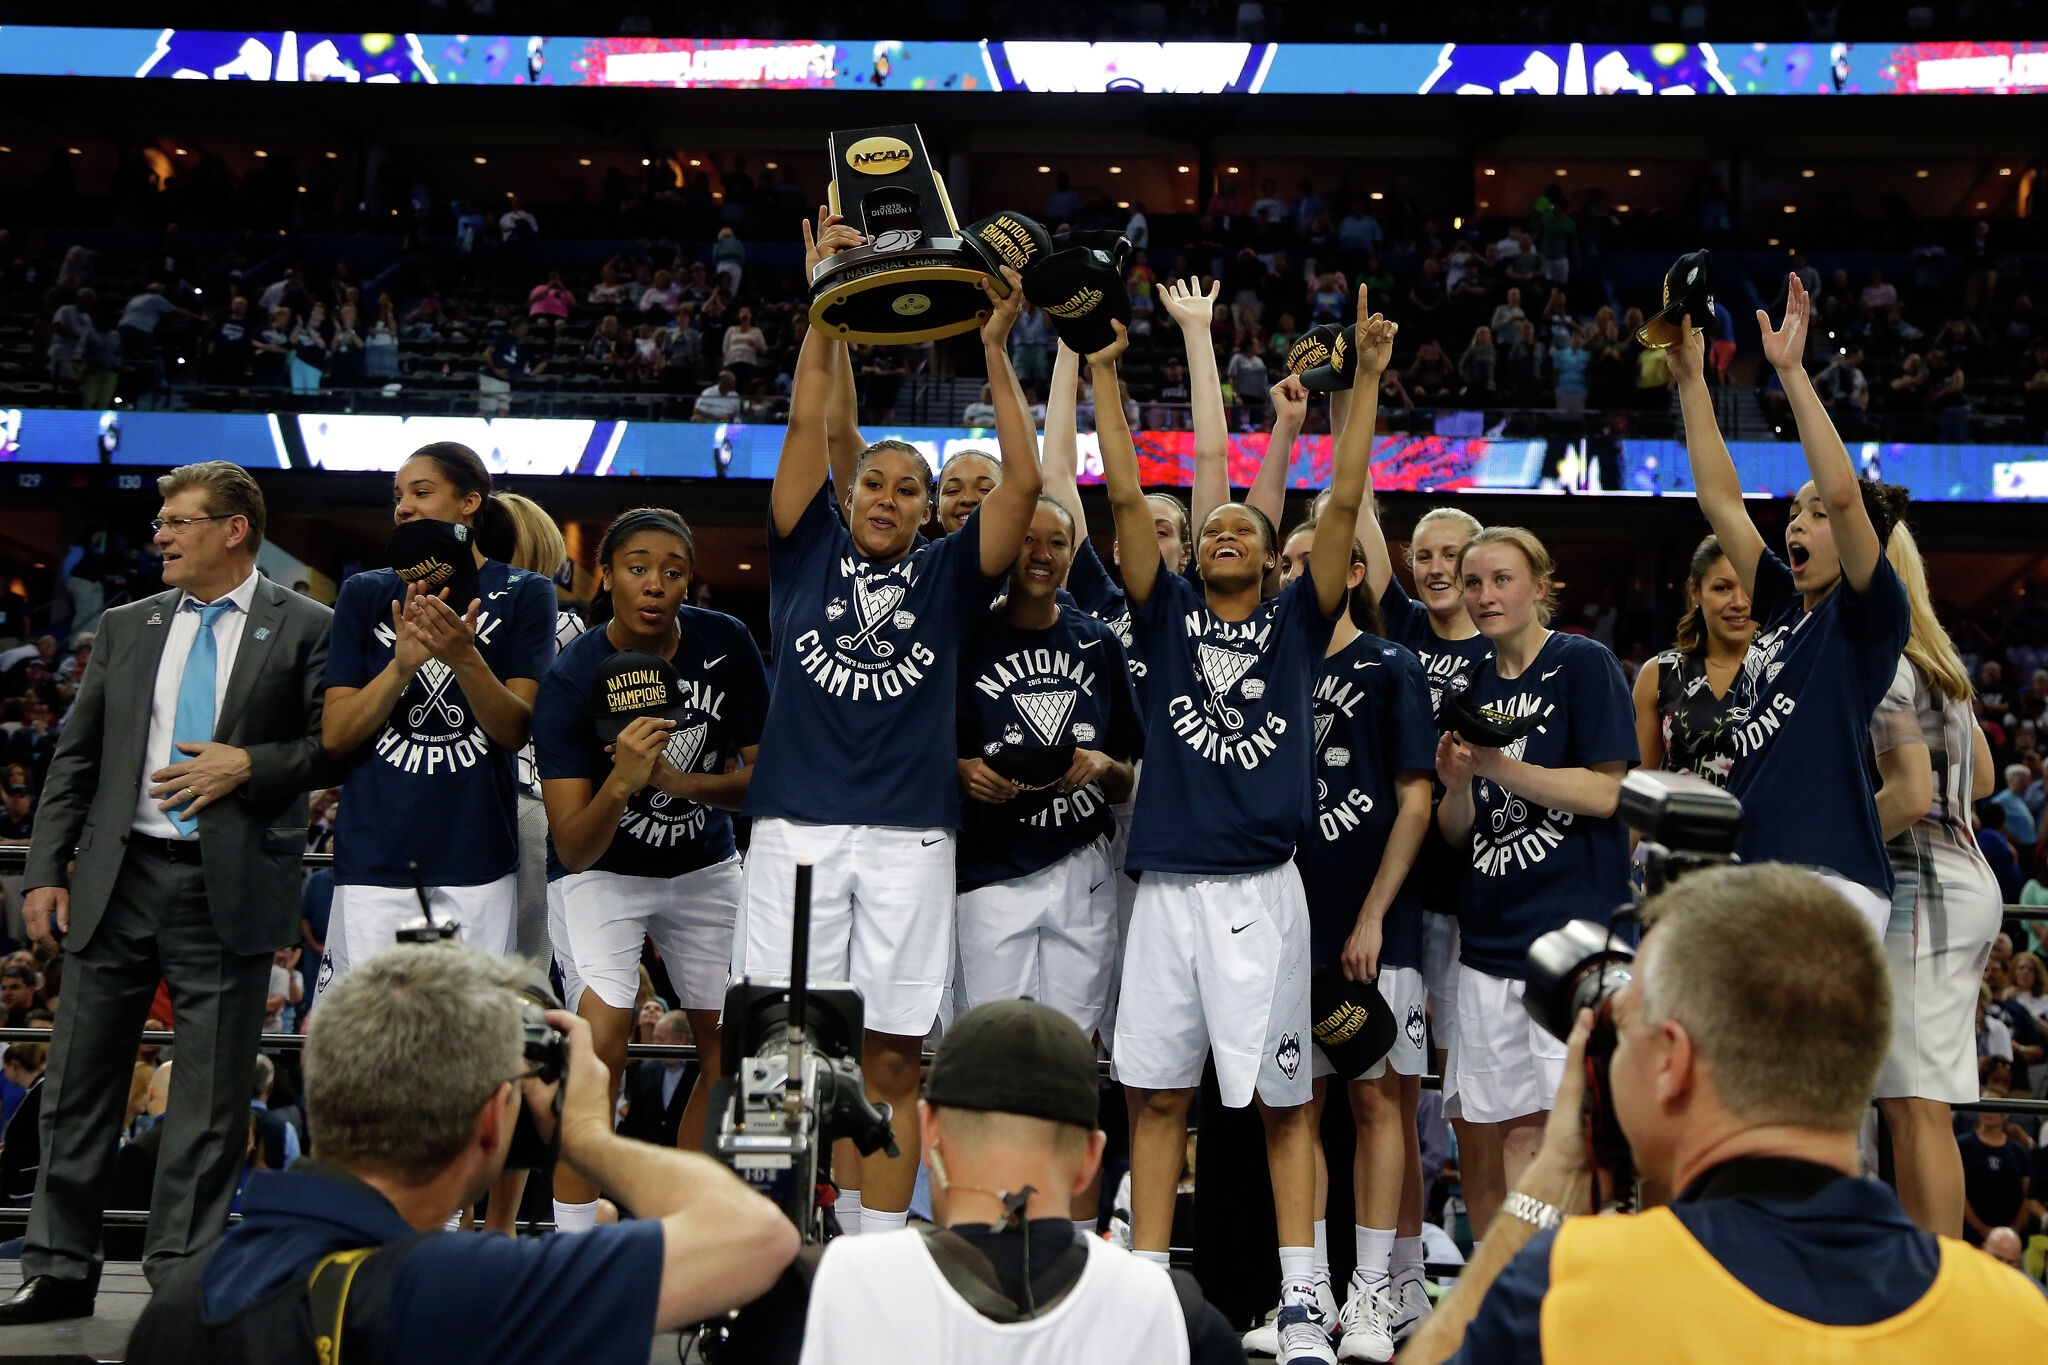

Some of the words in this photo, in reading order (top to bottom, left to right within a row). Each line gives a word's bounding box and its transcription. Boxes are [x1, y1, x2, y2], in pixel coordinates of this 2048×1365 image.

[854, 149, 910, 165] NCAA
[871, 207, 907, 217] DIVISION
[983, 223, 1029, 269] CHAMPIONS
[995, 215, 1038, 260] NATIONAL
[846, 260, 905, 280] NATIONAL
[117, 475, 142, 489] 130
[795, 629, 935, 701] CHAMPIONS
[834, 650, 857, 667] WOMEN'S
[857, 660, 892, 670] BASKETBALL
[606, 669, 664, 692] NATIONAL
[975, 648, 1096, 700] NATIONAL
[1027, 677, 1042, 687] 2015
[607, 684, 667, 707] CHAMPIONS
[430, 730, 463, 743] BASKETBALL
[375, 725, 490, 775] HAMPION
[1311, 1000, 1357, 1037] NATIONAL
